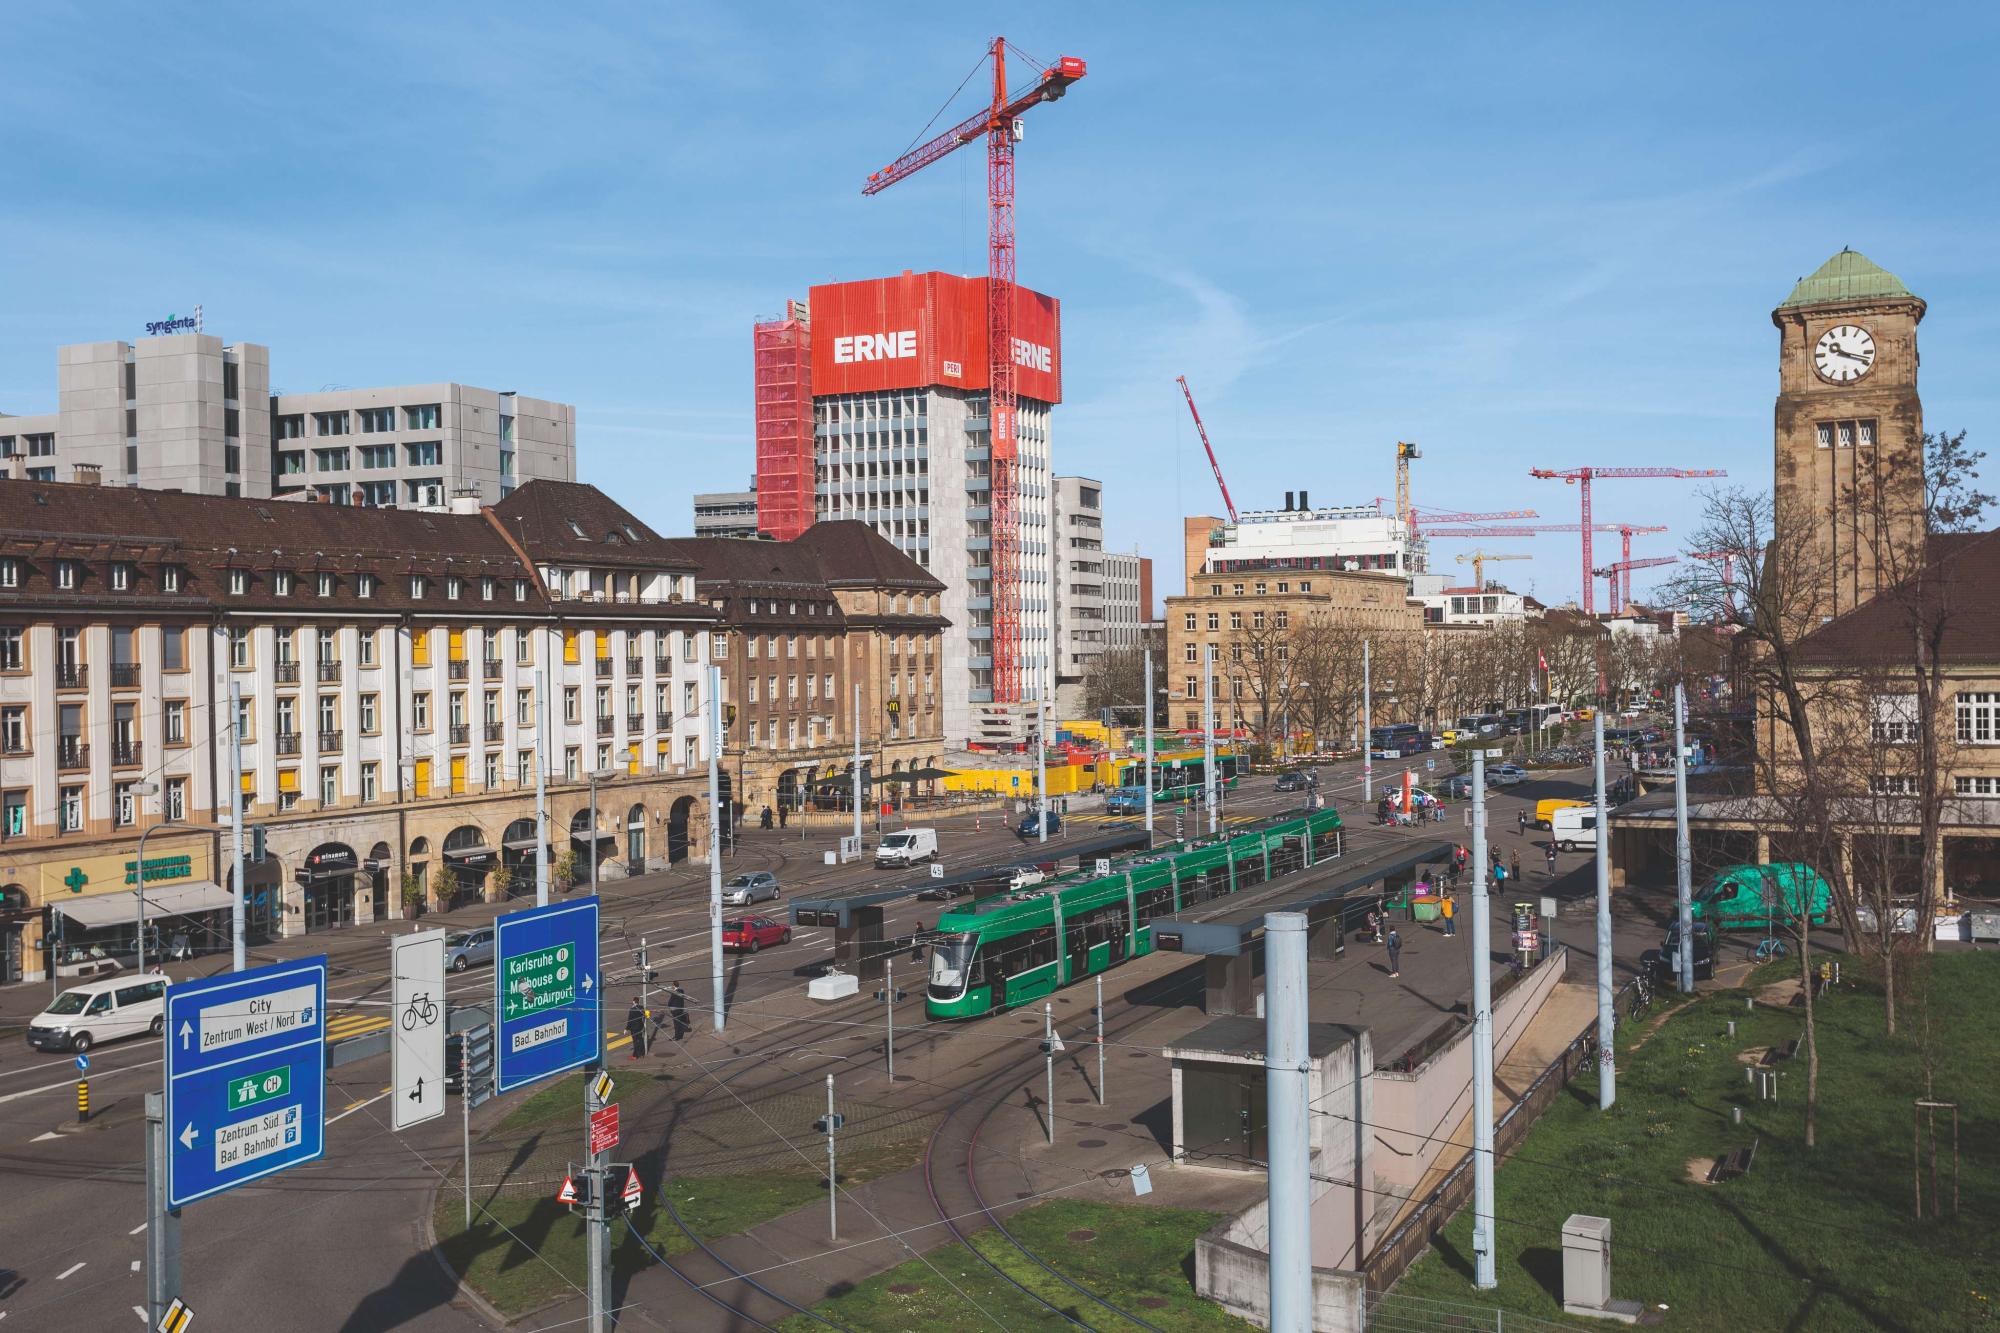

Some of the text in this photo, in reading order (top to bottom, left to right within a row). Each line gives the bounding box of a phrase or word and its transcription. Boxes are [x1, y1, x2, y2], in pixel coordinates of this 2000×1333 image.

[146, 316, 195, 335] syngenta
[834, 330, 917, 364] ERNE
[1010, 337, 1052, 373] ERNE
[946, 362, 960, 374] PERI
[998, 412, 1006, 440] ERNE
[125, 855, 191, 871] HIZBRUNNEN
[932, 866, 942, 876] 45
[1097, 861, 1108, 871] 45
[510, 953, 553, 975] Karlsruhe
[510, 973, 553, 995] Mhouse
[250, 1000, 272, 1015] City
[523, 985, 573, 1010] EuroAirport
[204, 1027, 242, 1047] Zentrum
[246, 1021, 269, 1036] West
[270, 1016, 274, 1030] /
[276, 1013, 295, 1029] Nord
[514, 1022, 565, 1047] Bad. Bahnhof
[266, 1076, 278, 1092] CH
[221, 1124, 258, 1144] Zentrum
[263, 1115, 279, 1132] Süd
[221, 1148, 240, 1164] Bad.
[244, 1135, 279, 1157] Bahnhof
